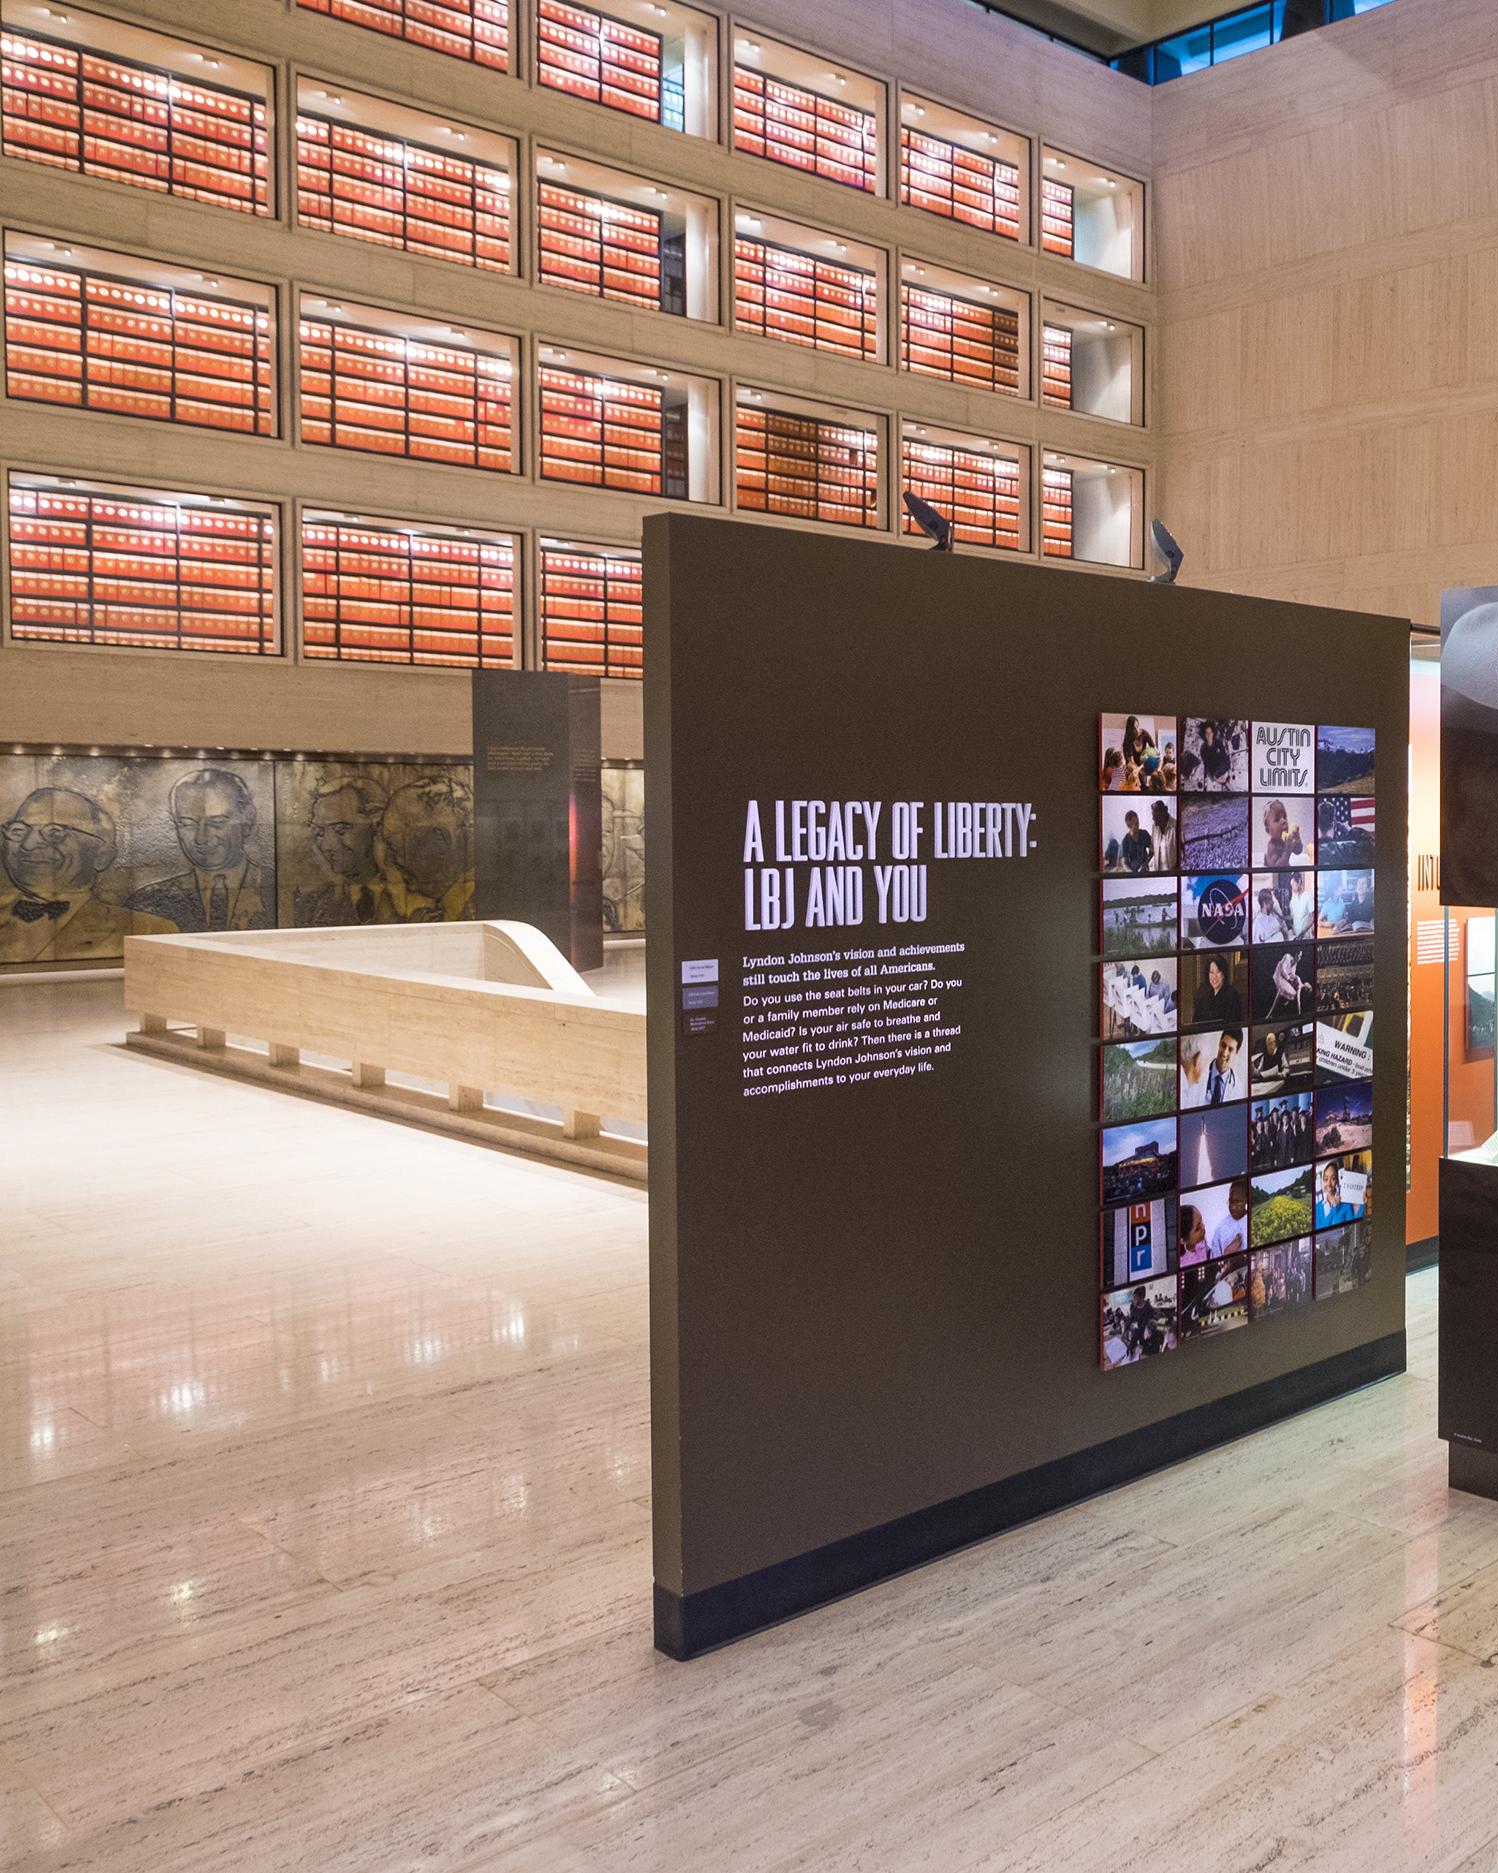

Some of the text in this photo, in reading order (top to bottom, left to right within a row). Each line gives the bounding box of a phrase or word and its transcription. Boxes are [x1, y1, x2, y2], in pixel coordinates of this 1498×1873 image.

[1256, 727, 1310, 747] AUSTIN
[1266, 748, 1300, 766] CITY
[1260, 768, 1308, 787] LIMITS
[743, 800, 1037, 863] A LEGACY OF LIBERTY:
[745, 865, 927, 930] LBJ AND YOU
[1202, 903, 1244, 917] NASA
[743, 943, 965, 969] Lyndon Johnson's vision and achievements
[743, 962, 936, 986] still touch the lives of all Americans.
[743, 979, 962, 1007] Do you use the seat belts in your car? Do you
[743, 997, 938, 1024] or a family member rely on Medicare or
[743, 1011, 941, 1042] Medicaid? Is your air safe to breathe and
[742, 1025, 961, 1062] your water fit to drink? Then there is a thread
[743, 1042, 951, 1078] that connects Lyndon Johnson's vision and
[1330, 1053, 1353, 1065] HAZARD
[743, 1062, 934, 1097] accomplishments to your everyday life.
